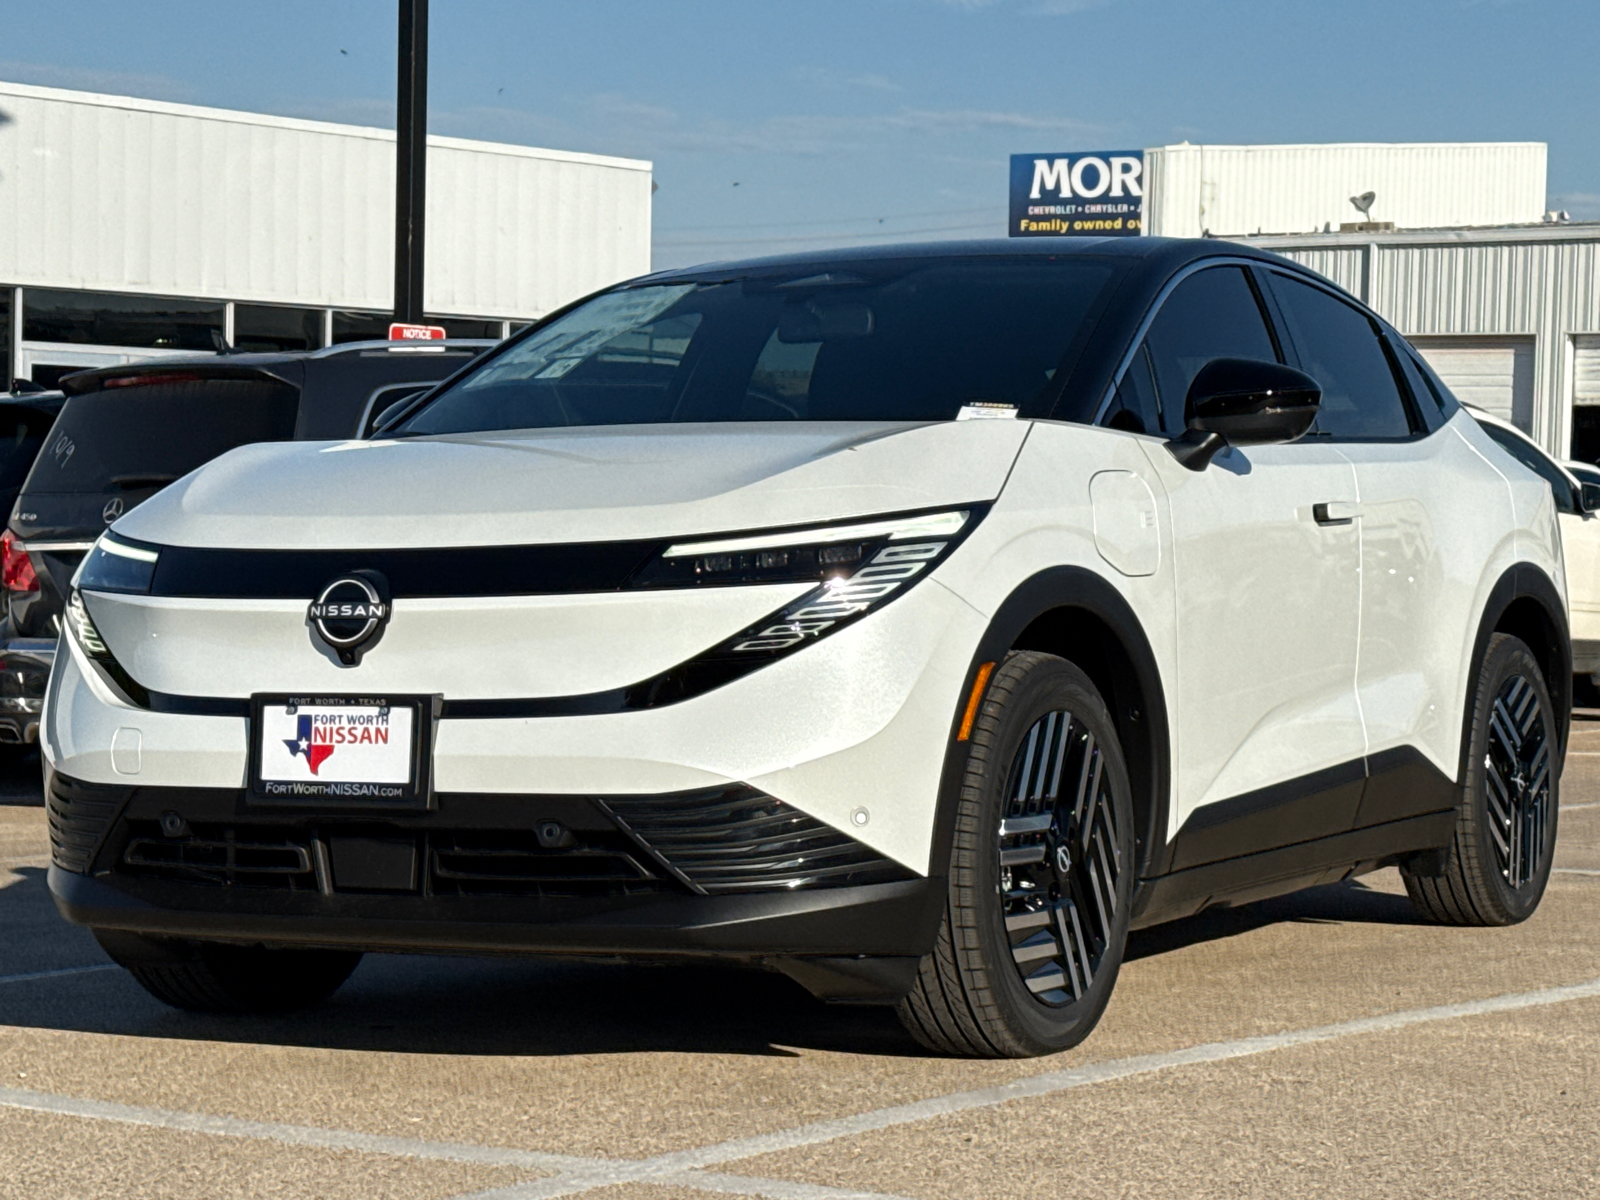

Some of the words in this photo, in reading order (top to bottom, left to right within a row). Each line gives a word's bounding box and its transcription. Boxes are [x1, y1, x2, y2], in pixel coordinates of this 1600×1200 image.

[1029, 156, 1143, 199] MOR
[1028, 205, 1076, 215] CHEVROLET
[1085, 204, 1128, 213] CHRYSLER
[1020, 219, 1069, 233] Family
[1073, 217, 1122, 230] owned
[403, 328, 431, 340] NOTICE
[310, 604, 383, 616] NISSAN
[289, 697, 311, 705] FORT
[314, 698, 345, 706] WORTH
[358, 698, 387, 706] TEXAS
[313, 714, 344, 725] FORT
[347, 715, 389, 726] WORTH
[313, 726, 389, 744] NISSAN
